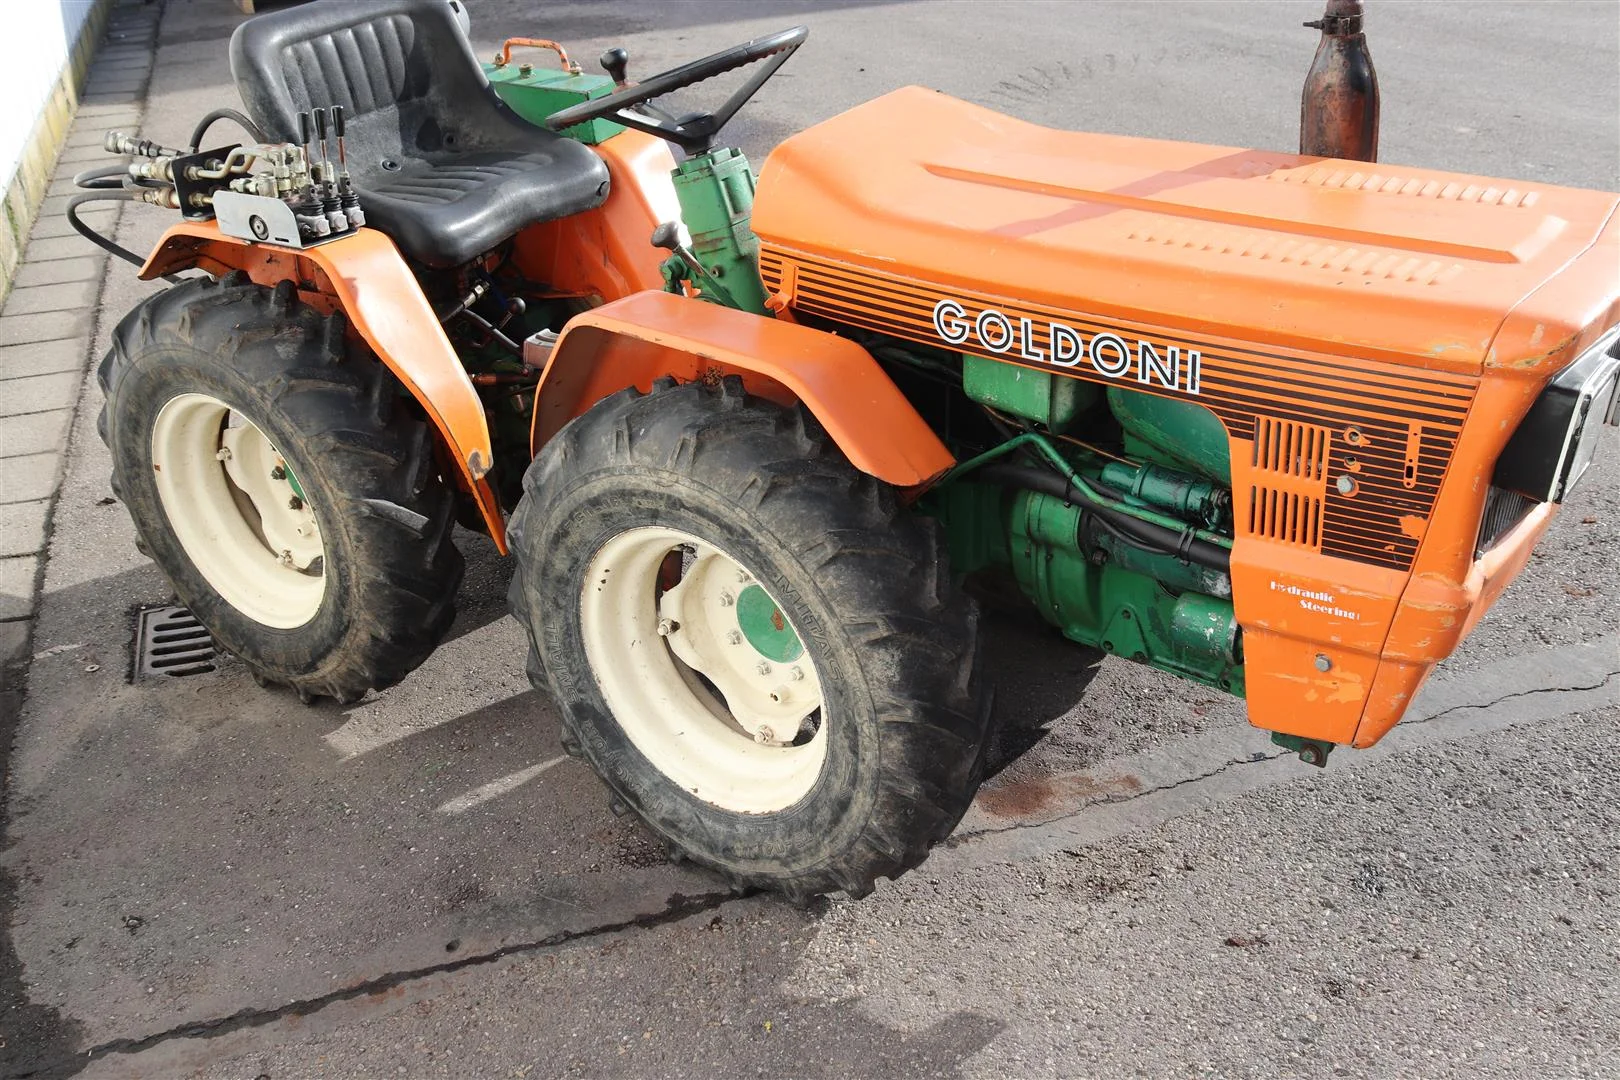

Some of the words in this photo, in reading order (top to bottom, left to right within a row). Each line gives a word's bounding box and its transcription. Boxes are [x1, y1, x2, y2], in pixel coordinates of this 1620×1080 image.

[933, 299, 1201, 395] GOLDONI
[776, 575, 845, 681] MITAS
[1299, 599, 1357, 620] Steering
[546, 621, 582, 704] SMALL
